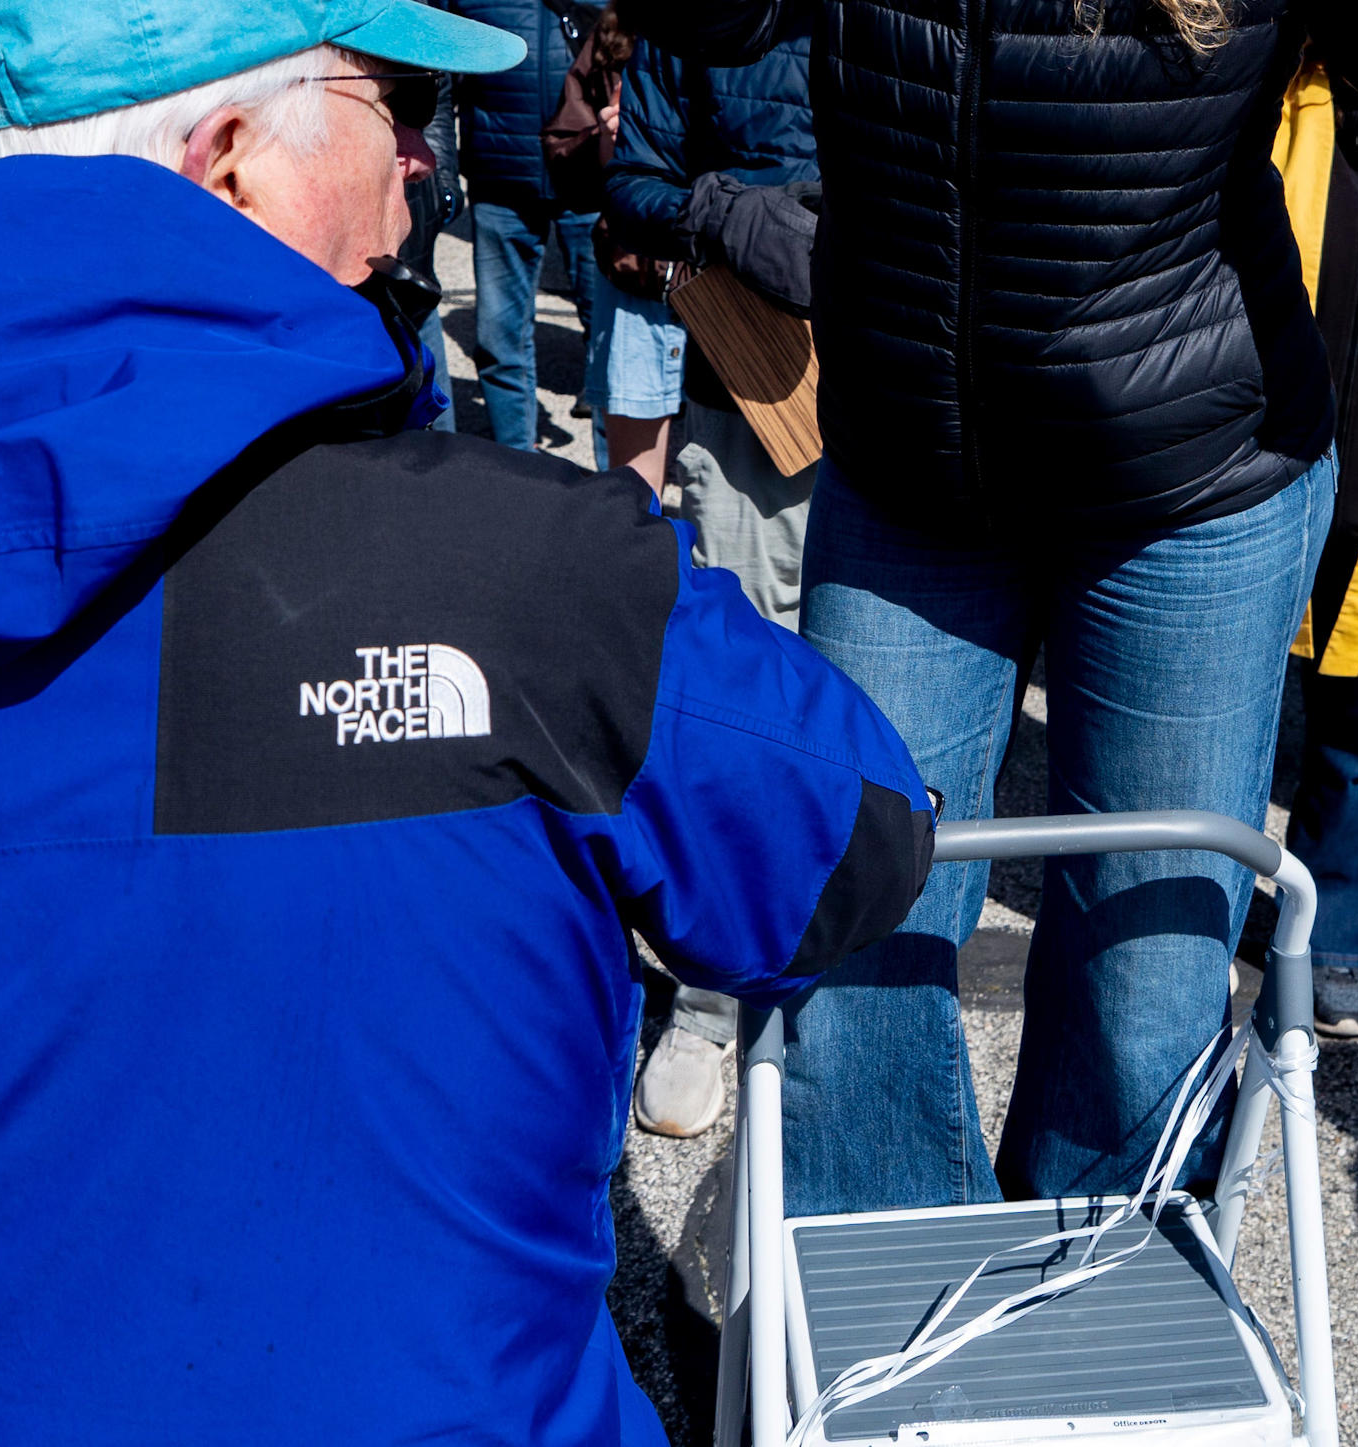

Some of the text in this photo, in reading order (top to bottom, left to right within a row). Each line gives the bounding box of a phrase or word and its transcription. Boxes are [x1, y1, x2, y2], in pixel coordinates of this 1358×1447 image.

[355, 644, 428, 679] THE
[299, 675, 427, 716] NORTH
[336, 706, 428, 746] FACE
